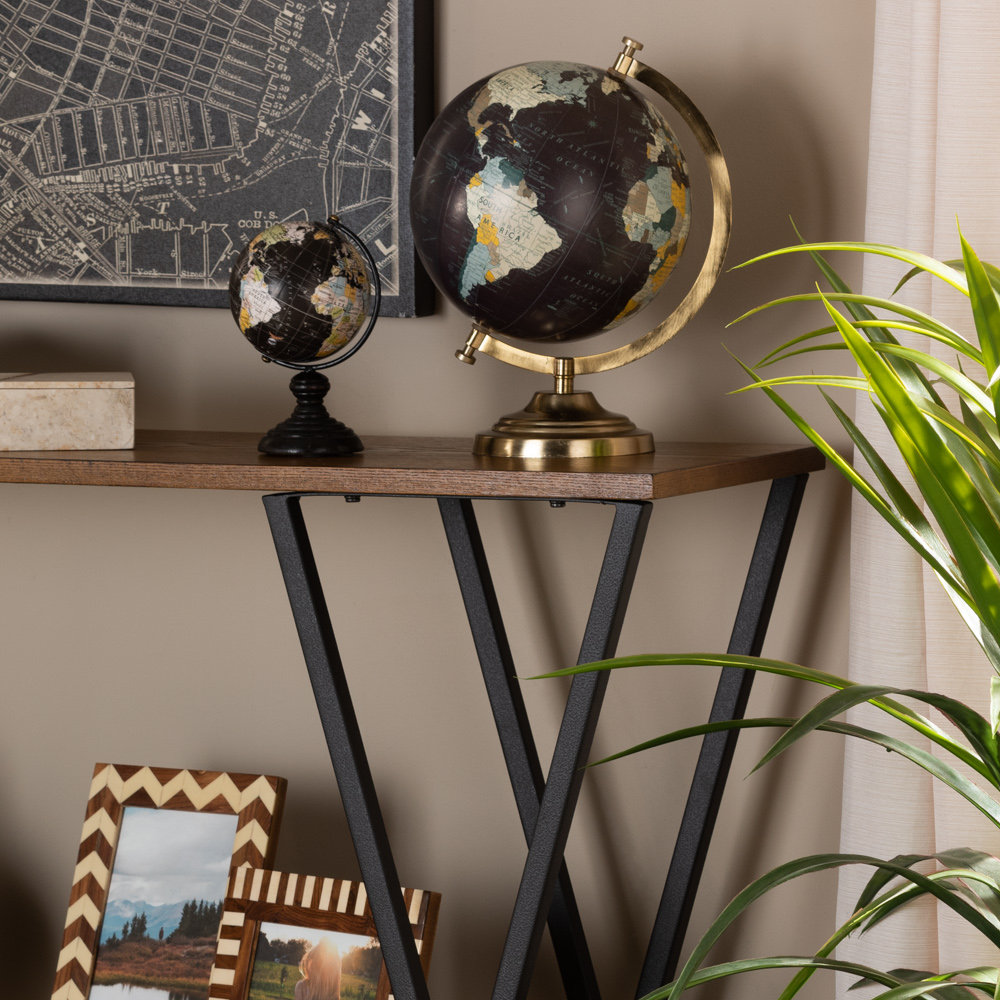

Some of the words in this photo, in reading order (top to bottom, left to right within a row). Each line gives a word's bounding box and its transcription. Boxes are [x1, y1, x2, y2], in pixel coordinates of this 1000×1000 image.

[478, 196, 502, 213] SOUTH
[253, 210, 279, 220] U.S.
[238, 219, 262, 229] COB
[477, 214, 521, 242] AMERICA
